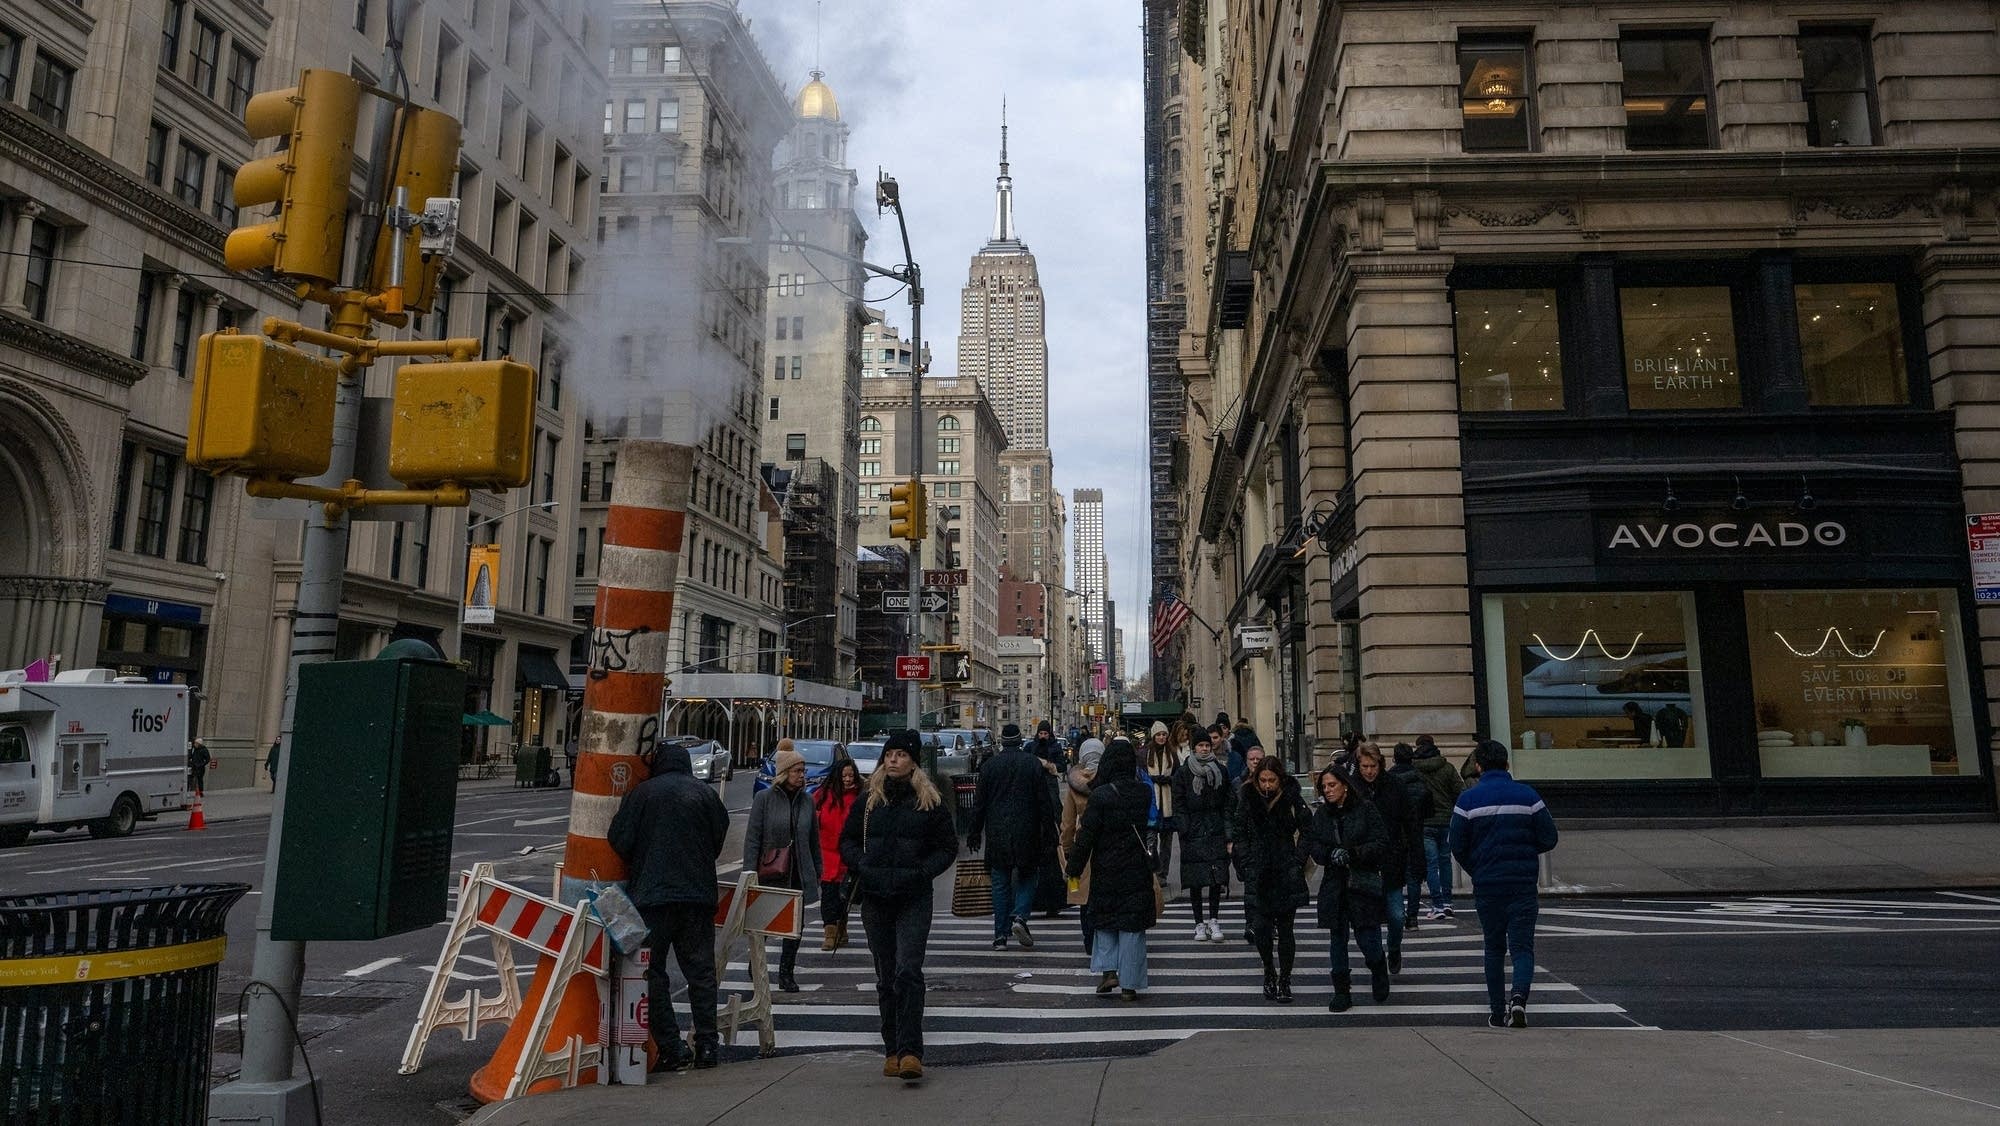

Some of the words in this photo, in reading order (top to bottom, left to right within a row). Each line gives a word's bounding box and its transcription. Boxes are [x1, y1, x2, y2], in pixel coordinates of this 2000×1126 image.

[1634, 357, 1729, 373] BRILLIANT
[1653, 375, 1713, 390] EARTH
[1608, 521, 1846, 548] AVOCADO
[1973, 540, 1980, 550] 3
[929, 575, 934, 585] E
[939, 574, 950, 585] 20
[954, 573, 963, 584] St
[147, 600, 159, 615] GAP
[888, 599, 909, 607] ONE
[1246, 636, 1269, 644] Theory
[158, 670, 170, 682] GAP
[1801, 669, 1842, 683] SAVE
[1848, 668, 1880, 683] 10%
[1803, 687, 1919, 703] EVERYTHING!
[131, 708, 164, 733] fios
[19, 967, 37, 976] New
[40, 965, 60, 976] York
